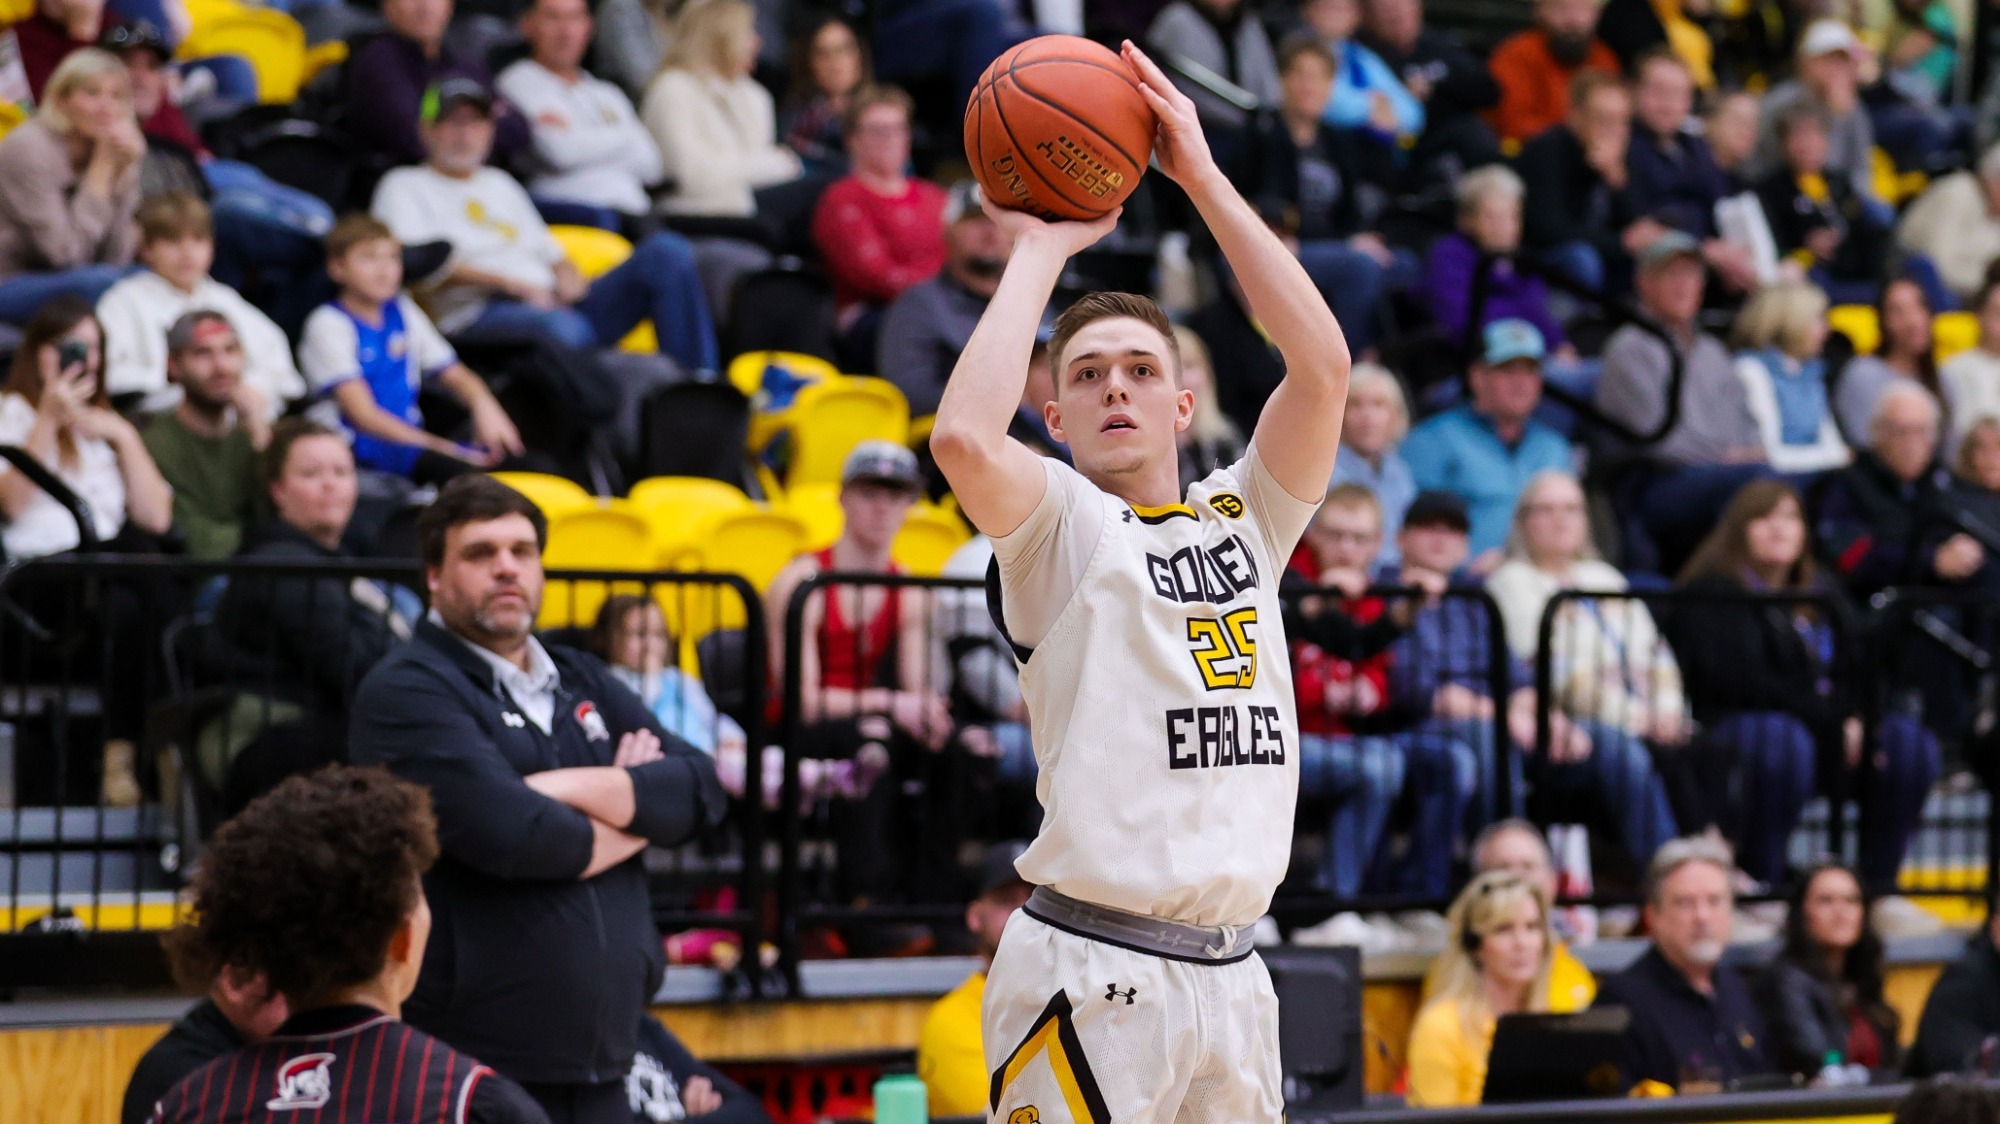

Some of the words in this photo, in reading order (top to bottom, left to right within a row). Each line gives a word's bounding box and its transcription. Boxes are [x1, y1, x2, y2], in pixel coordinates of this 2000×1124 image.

[1036, 140, 1119, 202] LEGACY
[1211, 496, 1241, 516] TS
[1145, 534, 1261, 605] GOLDEN
[1186, 606, 1258, 691] 25
[1165, 705, 1286, 770] EAGLES
